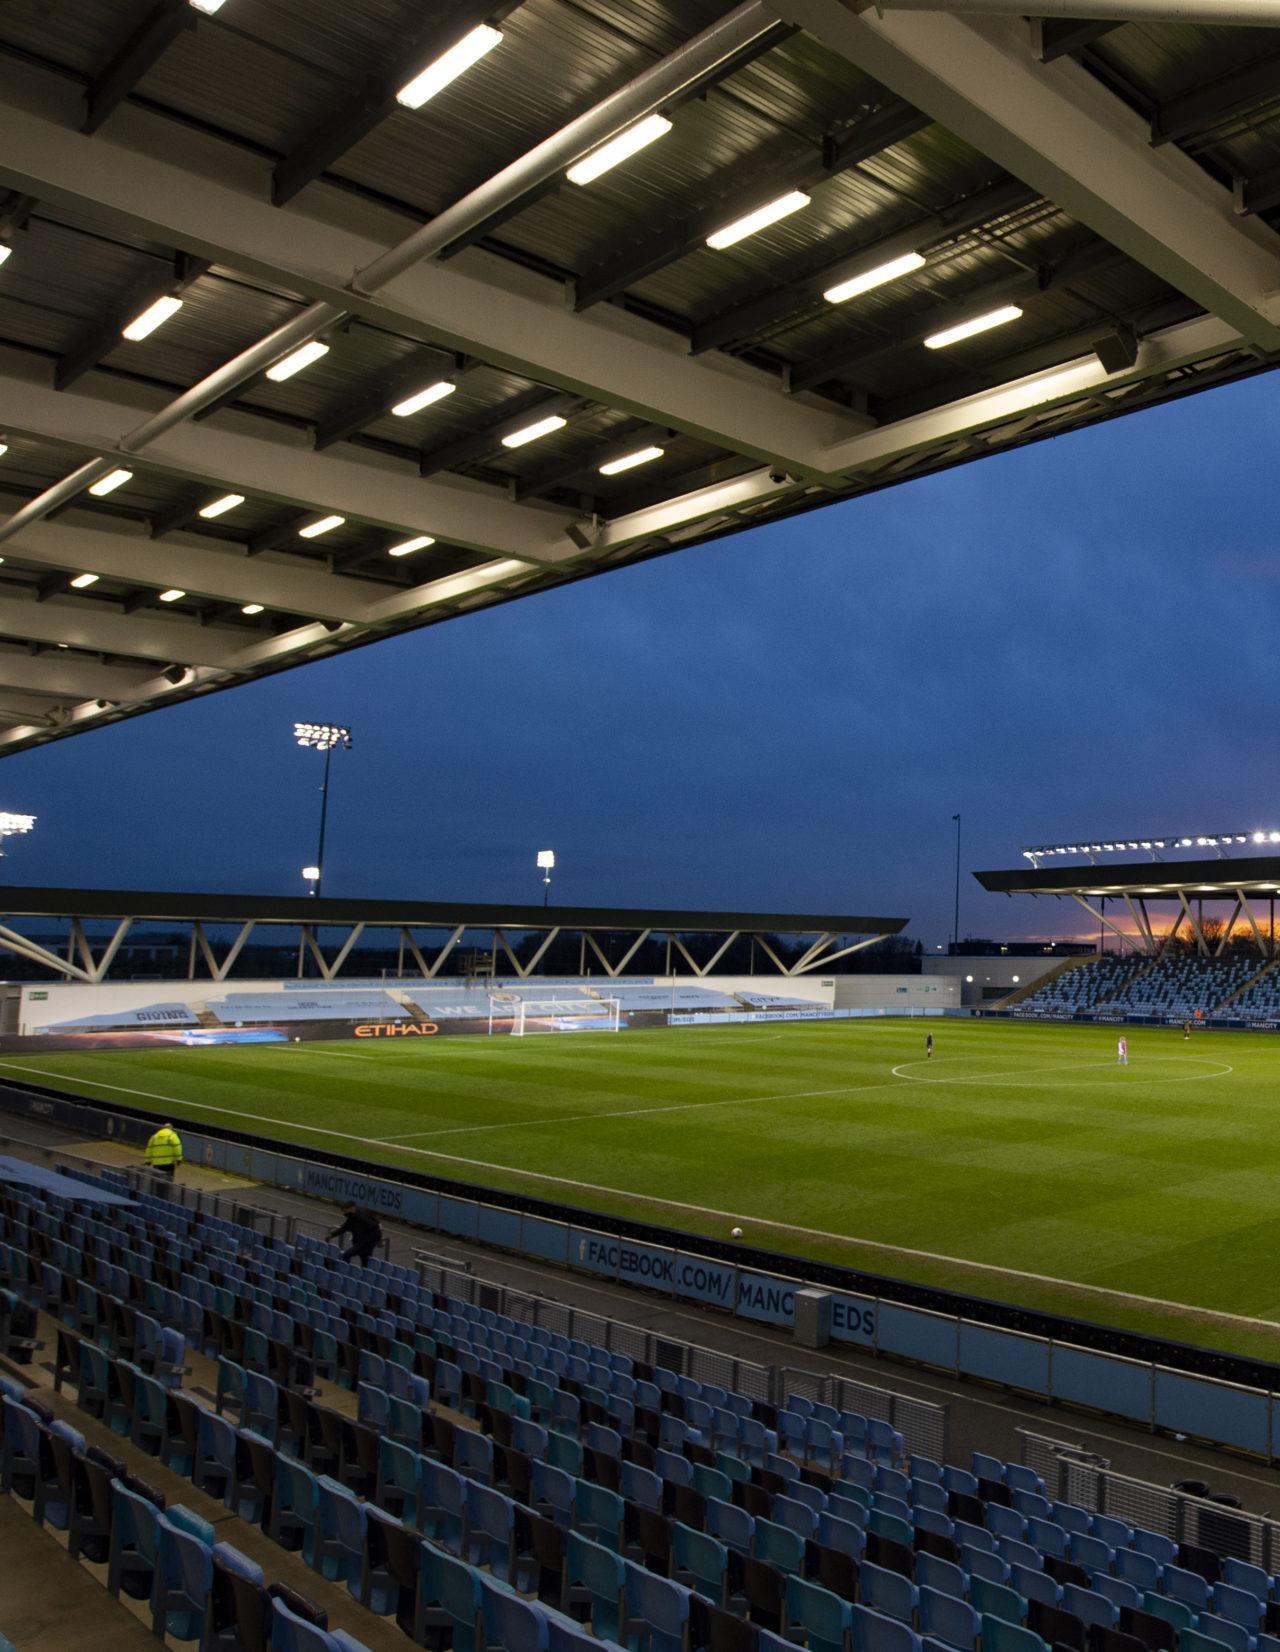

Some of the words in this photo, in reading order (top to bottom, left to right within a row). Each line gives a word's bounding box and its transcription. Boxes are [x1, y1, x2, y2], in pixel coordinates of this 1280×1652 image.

[434, 1005, 482, 1015] WE
[1168, 1018, 1206, 1026] MANCY.COM
[354, 1023, 439, 1037] ETIHAD
[307, 1169, 401, 1210] MANCITY.COM/EDS
